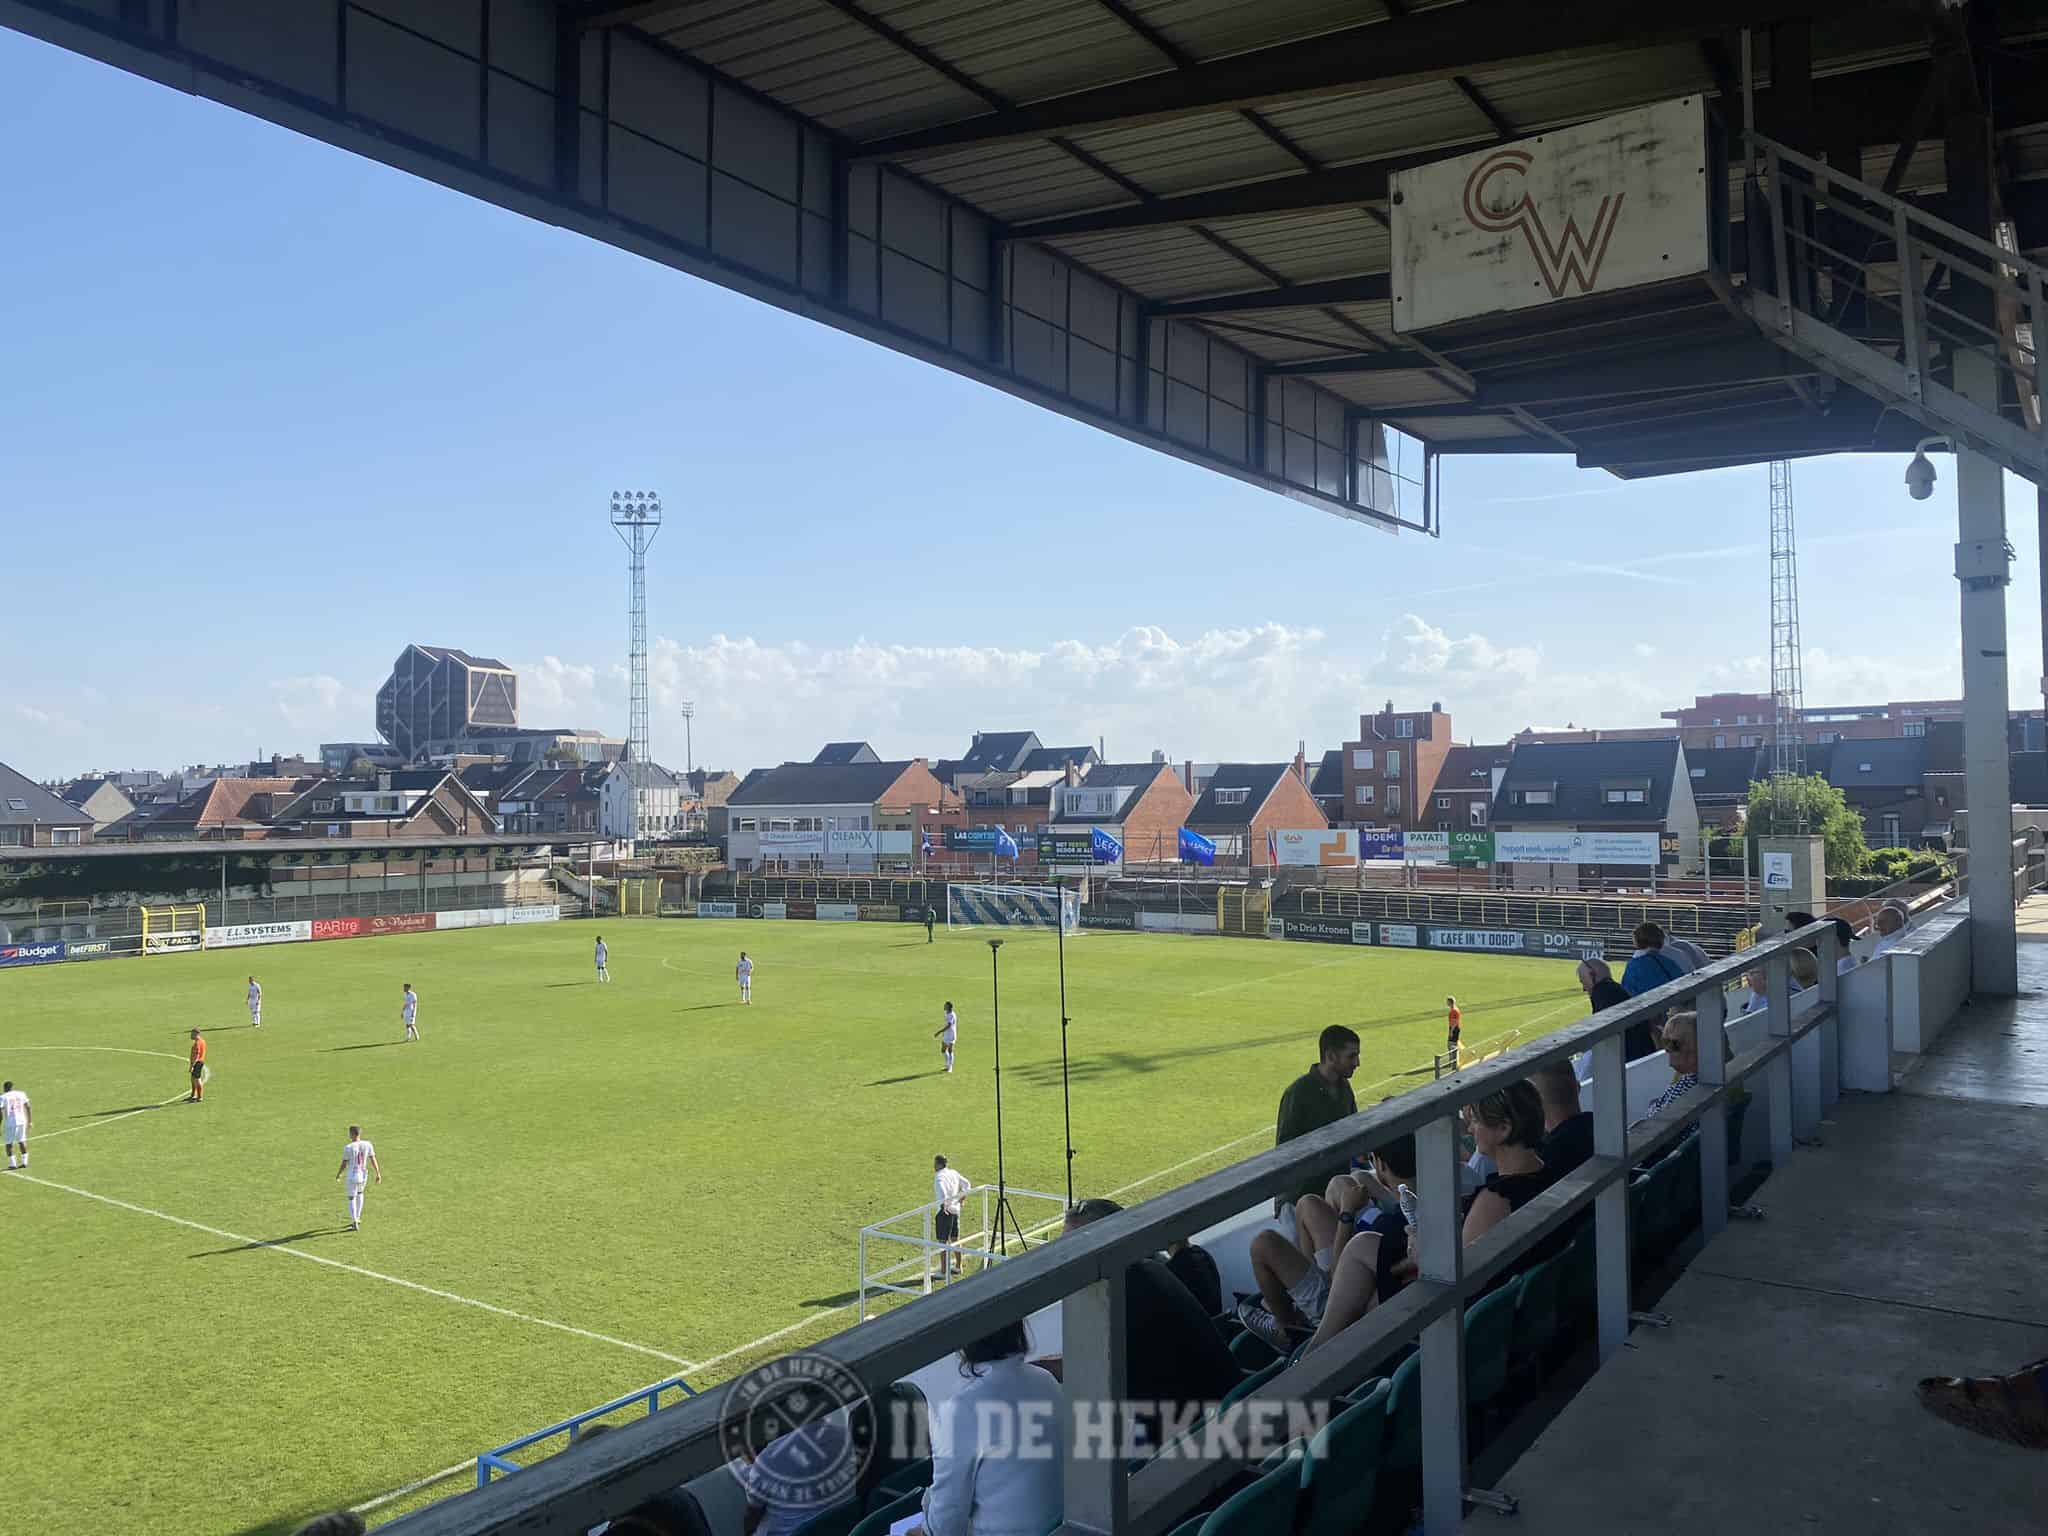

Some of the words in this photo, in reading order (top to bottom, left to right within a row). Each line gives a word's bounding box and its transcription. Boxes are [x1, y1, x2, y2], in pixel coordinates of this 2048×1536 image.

[1366, 832, 1397, 841] BOEM!
[1410, 833, 1443, 842] PATAT!
[1455, 833, 1487, 842] GOAL!
[1094, 837, 1119, 856] UEFA
[244, 925, 292, 936] SYSTEMS
[1287, 922, 1298, 931] De
[1300, 923, 1317, 932] Drie
[1318, 924, 1350, 934] Kronen
[1465, 933, 1475, 945] IN
[1489, 934, 1515, 946] DORP
[19, 944, 58, 957] Budget
[70, 943, 107, 954] betFIRST
